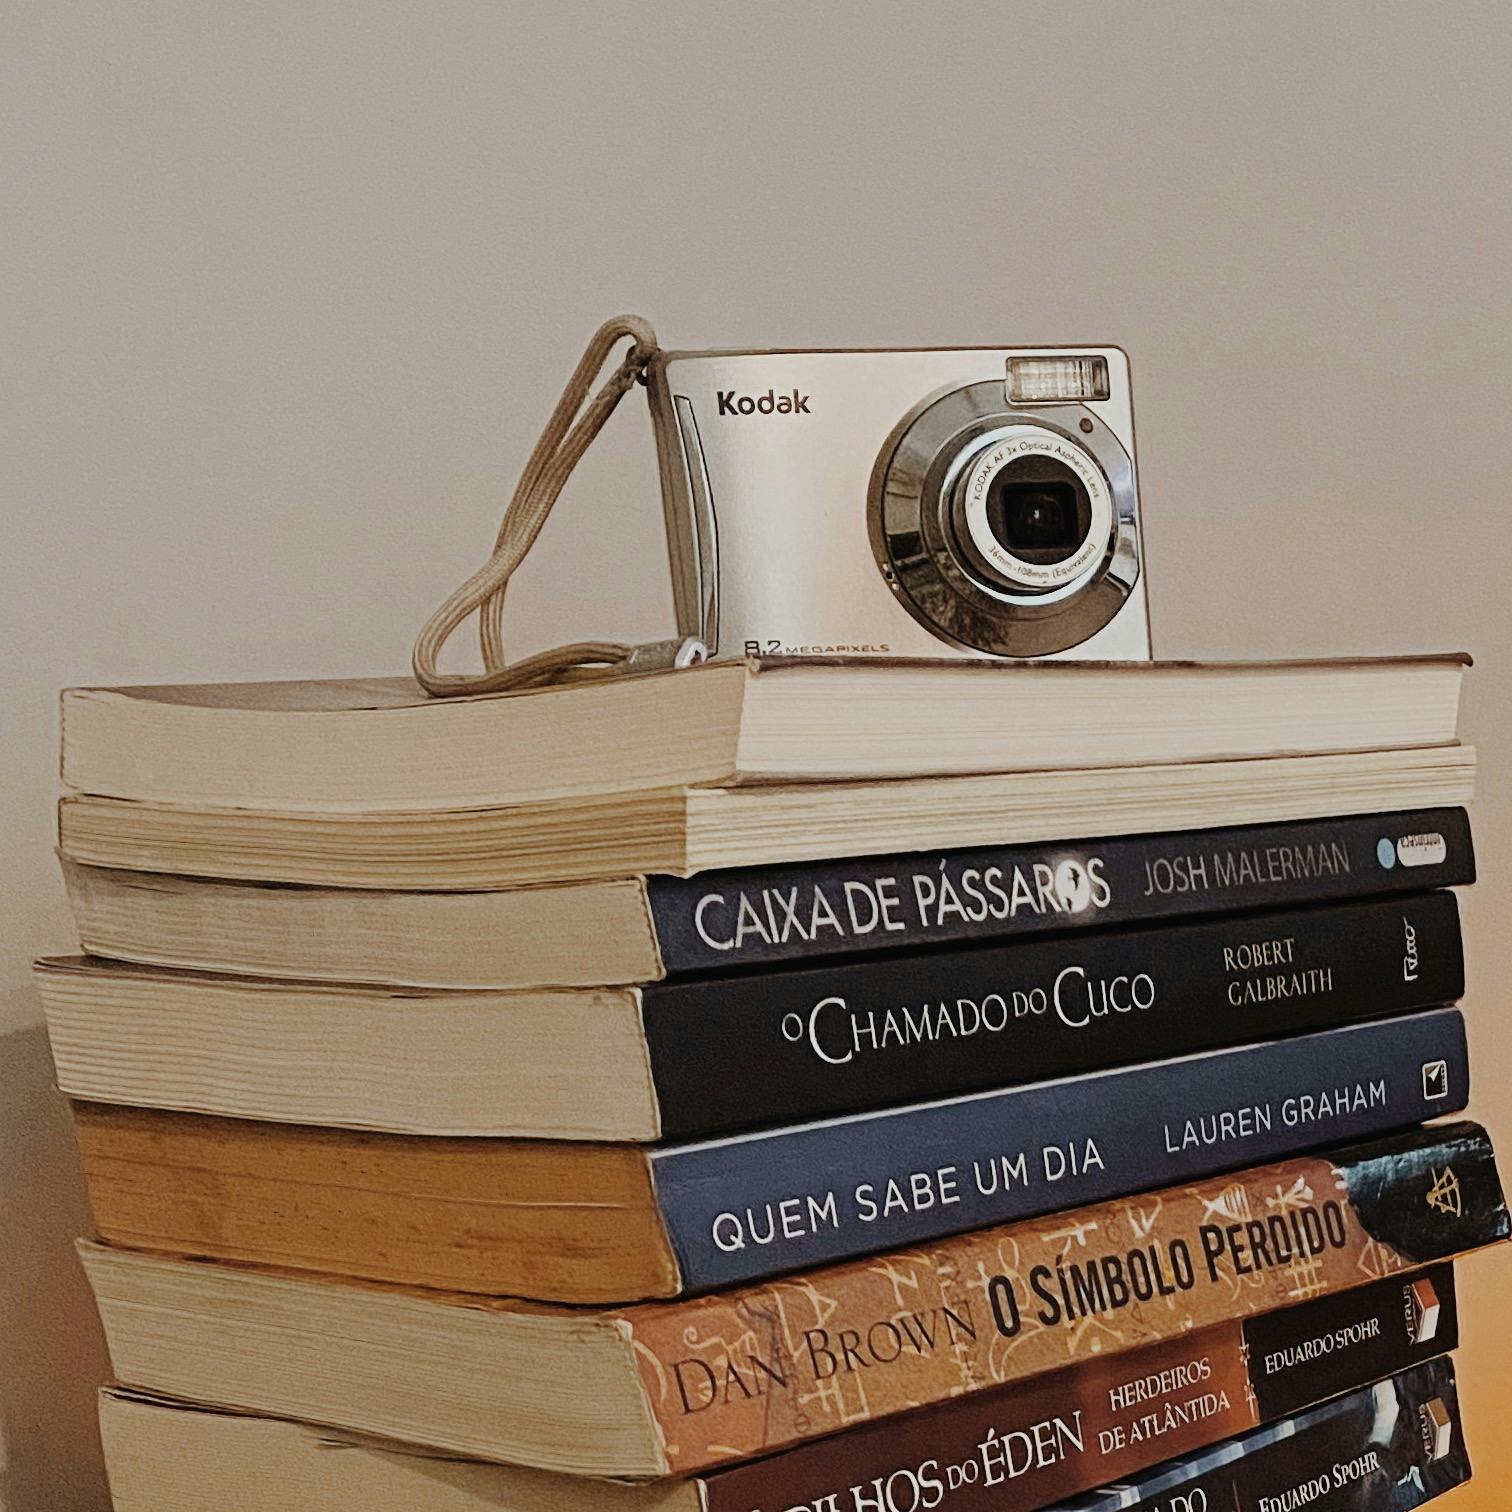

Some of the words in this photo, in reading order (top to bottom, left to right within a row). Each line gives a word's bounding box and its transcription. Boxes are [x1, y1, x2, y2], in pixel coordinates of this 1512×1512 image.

[718, 389, 811, 415] Kodak
[974, 465, 993, 501] KODAK
[1019, 441, 1052, 451] Optical
[1055, 446, 1089, 476] Aspheric
[785, 644, 891, 654] MEGAPIXELS
[1144, 855, 1208, 896] JOSH
[1213, 841, 1350, 888] MALERMAN
[695, 885, 845, 950] CAIXA
[844, 877, 905, 934] DE
[913, 858, 1111, 928] PÁSSAROS
[1223, 938, 1295, 972] ROBERT
[781, 1013, 803, 1042] O
[808, 994, 1007, 1064] CHAMADO
[1013, 987, 1047, 1018] DO
[1054, 966, 1155, 1027] CUCO
[1227, 968, 1333, 1007] GALBRAITH
[1164, 1105, 1272, 1155] LAUREN
[1281, 1079, 1388, 1126] GRAHAM
[712, 1191, 839, 1252] QUEM
[855, 1166, 960, 1222] SABE
[974, 1153, 1029, 1195] UM
[1043, 1138, 1105, 1182] DIA
[988, 1275, 1020, 1338] O
[1030, 1239, 1194, 1326] SÍMBOLO
[1200, 1200, 1346, 1283] PERDIDO
[1402, 1284, 1416, 1344] VERUS
[673, 1353, 789, 1415] DAN
[803, 1299, 977, 1381] BROWN
[1265, 1334, 1334, 1375] EDUARDO
[1336, 1317, 1381, 1349] SPOHR
[1109, 1358, 1212, 1411] HERDEIROS
[946, 1459, 979, 1491] DO
[977, 1410, 1084, 1487] ÉDEN
[1098, 1427, 1125, 1455] DE
[1129, 1391, 1231, 1442] ATLÂNTIDA
[1416, 1404, 1434, 1464] VERUS
[1332, 1451, 1380, 1490] SPOHR
